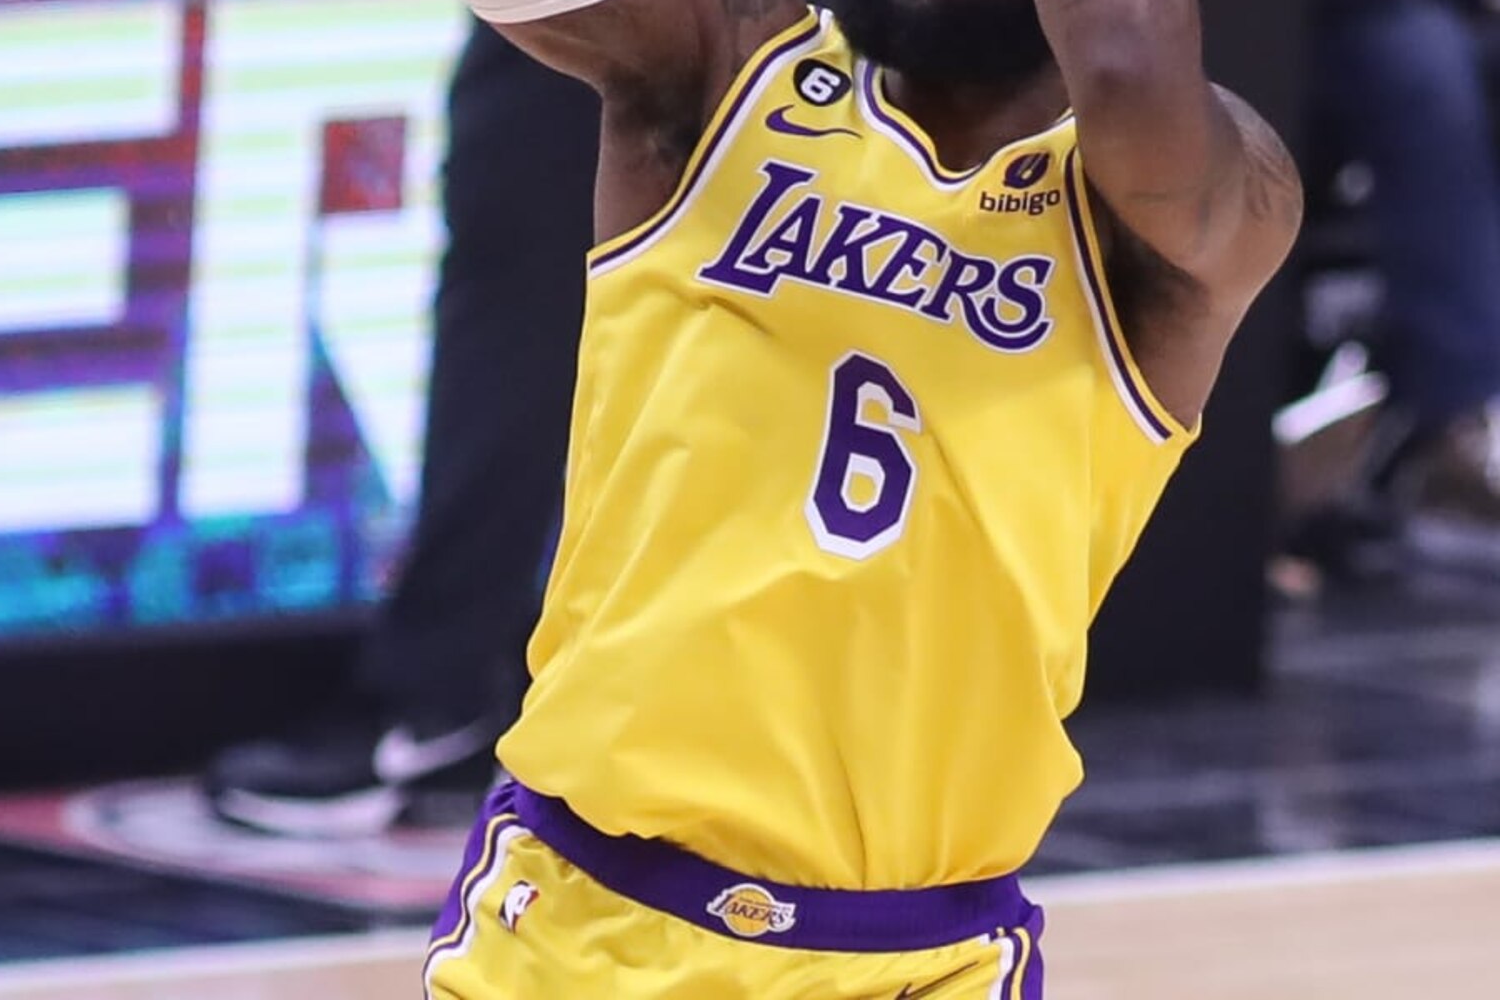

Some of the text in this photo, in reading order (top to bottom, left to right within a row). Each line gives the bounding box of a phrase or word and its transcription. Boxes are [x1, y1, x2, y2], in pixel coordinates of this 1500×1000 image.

[800, 67, 841, 103] 6
[694, 157, 1057, 353] LAKERS
[980, 189, 1061, 216] bibigo
[804, 349, 922, 560] 6
